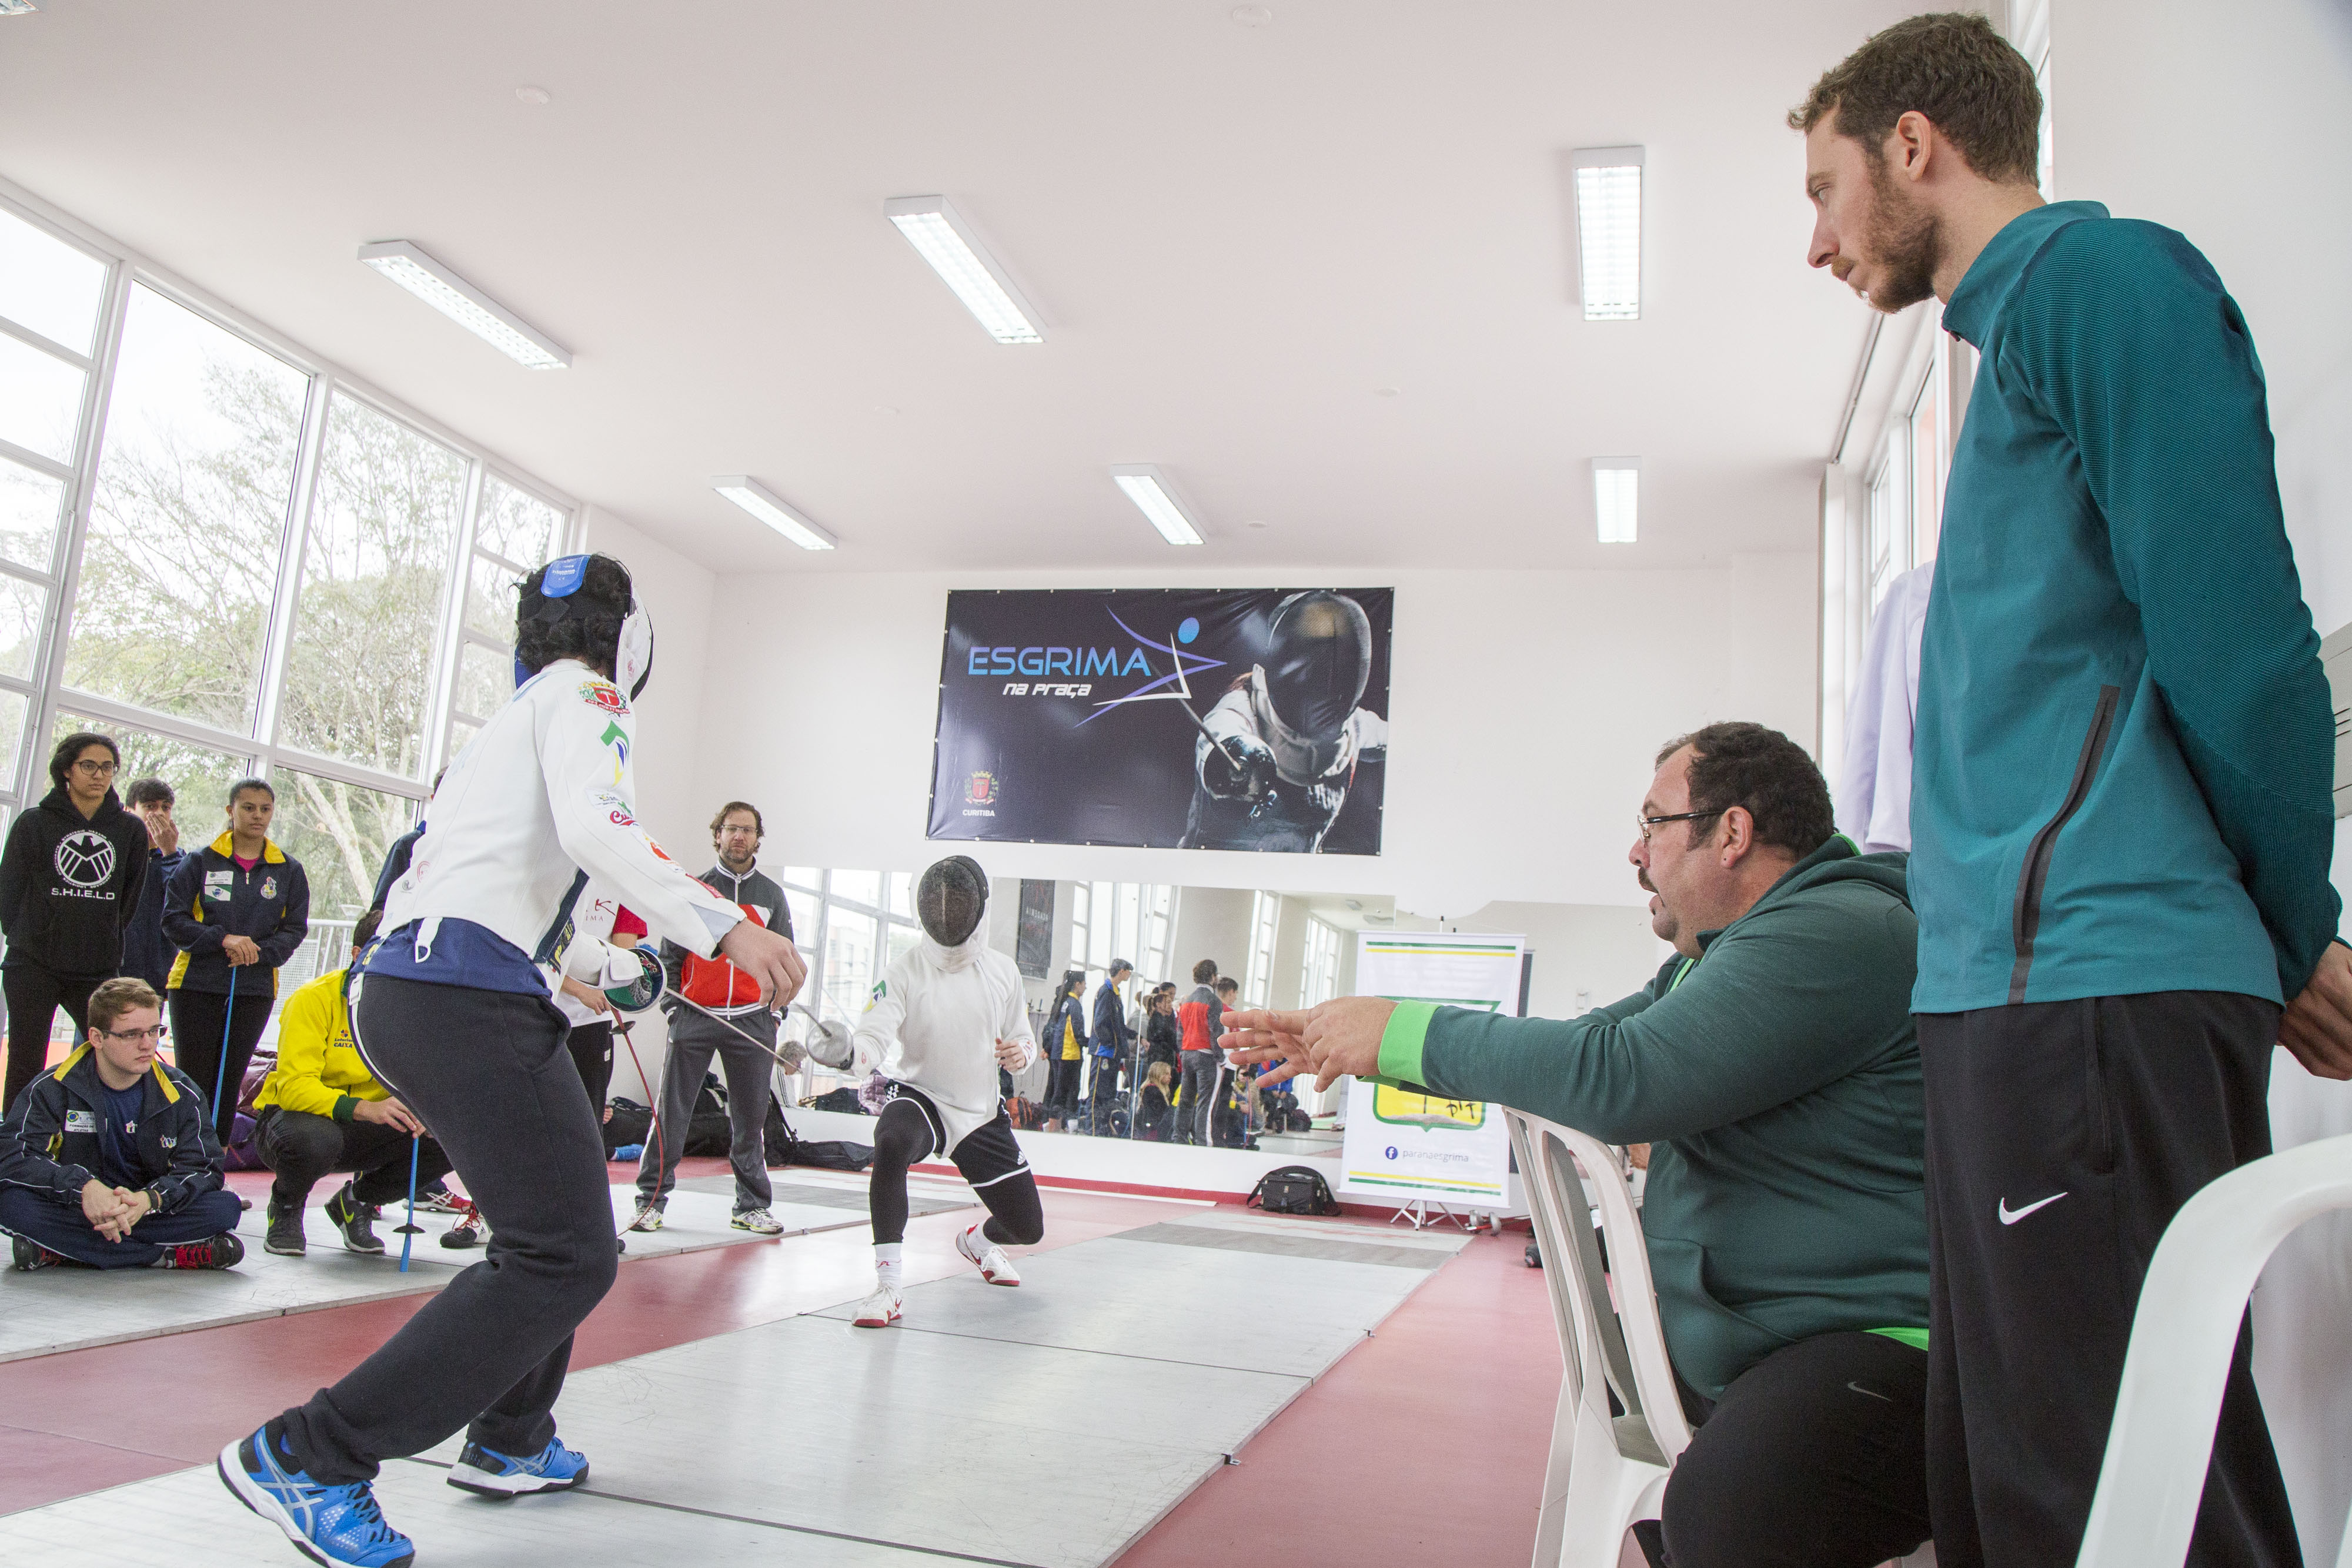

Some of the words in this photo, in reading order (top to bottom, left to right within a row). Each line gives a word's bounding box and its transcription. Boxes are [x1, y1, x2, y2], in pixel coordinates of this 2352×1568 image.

[968, 646, 1152, 677] ESGRIMA
[1003, 683, 1029, 696] na
[963, 809, 995, 817] CURITIBA
[51, 888, 115, 900] S.H.I.E.L.D
[1402, 1150, 1469, 1163] paranaesgrima
